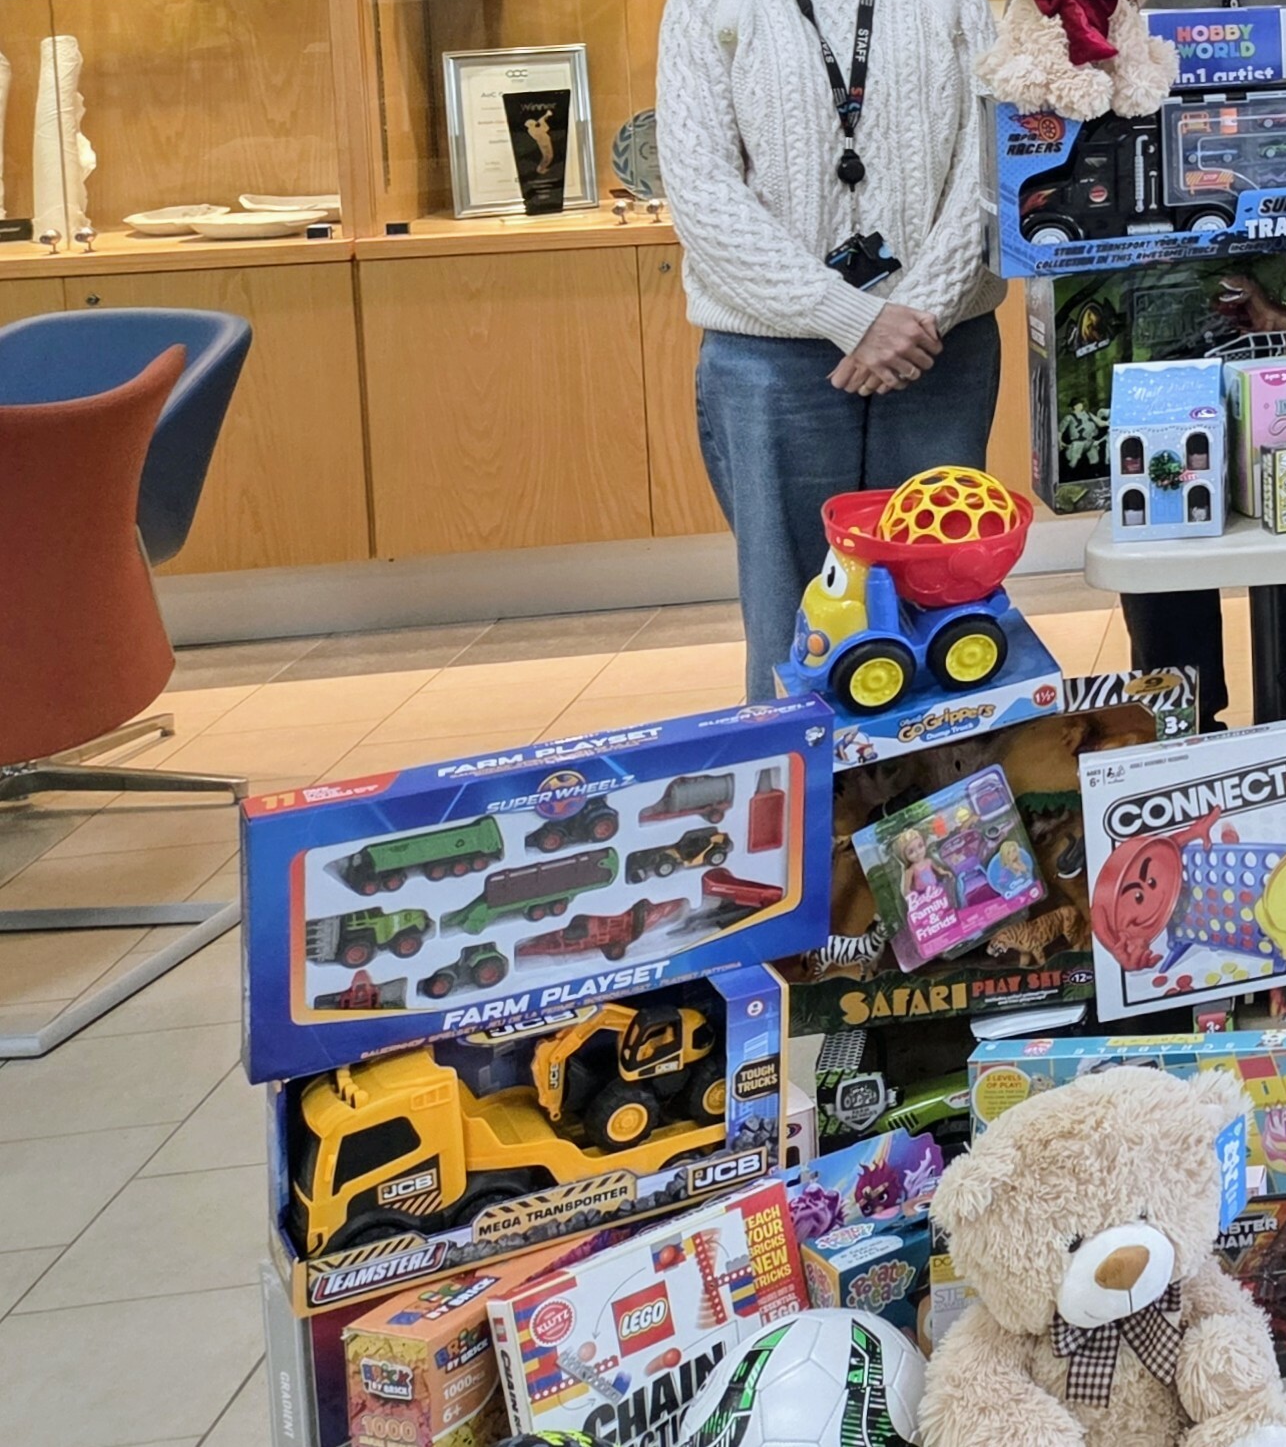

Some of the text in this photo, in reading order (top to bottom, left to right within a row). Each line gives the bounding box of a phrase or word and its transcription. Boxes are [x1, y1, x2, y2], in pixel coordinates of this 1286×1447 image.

[855, 28, 869, 63] STAFF
[1177, 24, 1254, 42] HOBBY
[1178, 42, 1256, 60] WORLD
[1213, 66, 1274, 83] artist
[1006, 142, 1064, 156] RACERS
[1162, 716, 1189, 734] 3+
[437, 726, 663, 777] FARM PLAYSET
[262, 792, 295, 810] 11
[485, 774, 636, 816] SUPER WHEELZ
[911, 896, 948, 925] Family
[916, 912, 958, 942] Friends
[443, 960, 671, 1030] FARM PLAYSET
[840, 971, 1062, 1025] SAFARI PLAY SET
[740, 1063, 775, 1083] TOUGH
[736, 1076, 778, 1096] TRUCKS
[694, 1154, 763, 1190] JCB
[383, 1175, 434, 1199] JCB
[479, 1186, 630, 1237] MEGA TRANSPORTER
[743, 1204, 781, 1228] TEACH
[748, 1220, 785, 1242] YOUR
[324, 1244, 435, 1295] TEAMSTERZ
[752, 1249, 789, 1273] NEW
[754, 1263, 792, 1290] TRICKS
[537, 1310, 571, 1335] KLUTZ
[621, 1301, 667, 1337] LEGO
[460, 1339, 490, 1365] BRICK
[384, 1382, 409, 1395] BRICK
[280, 1371, 295, 1439] GRADIENT
[443, 1405, 462, 1424] 6+
[361, 1416, 417, 1442] 1000
